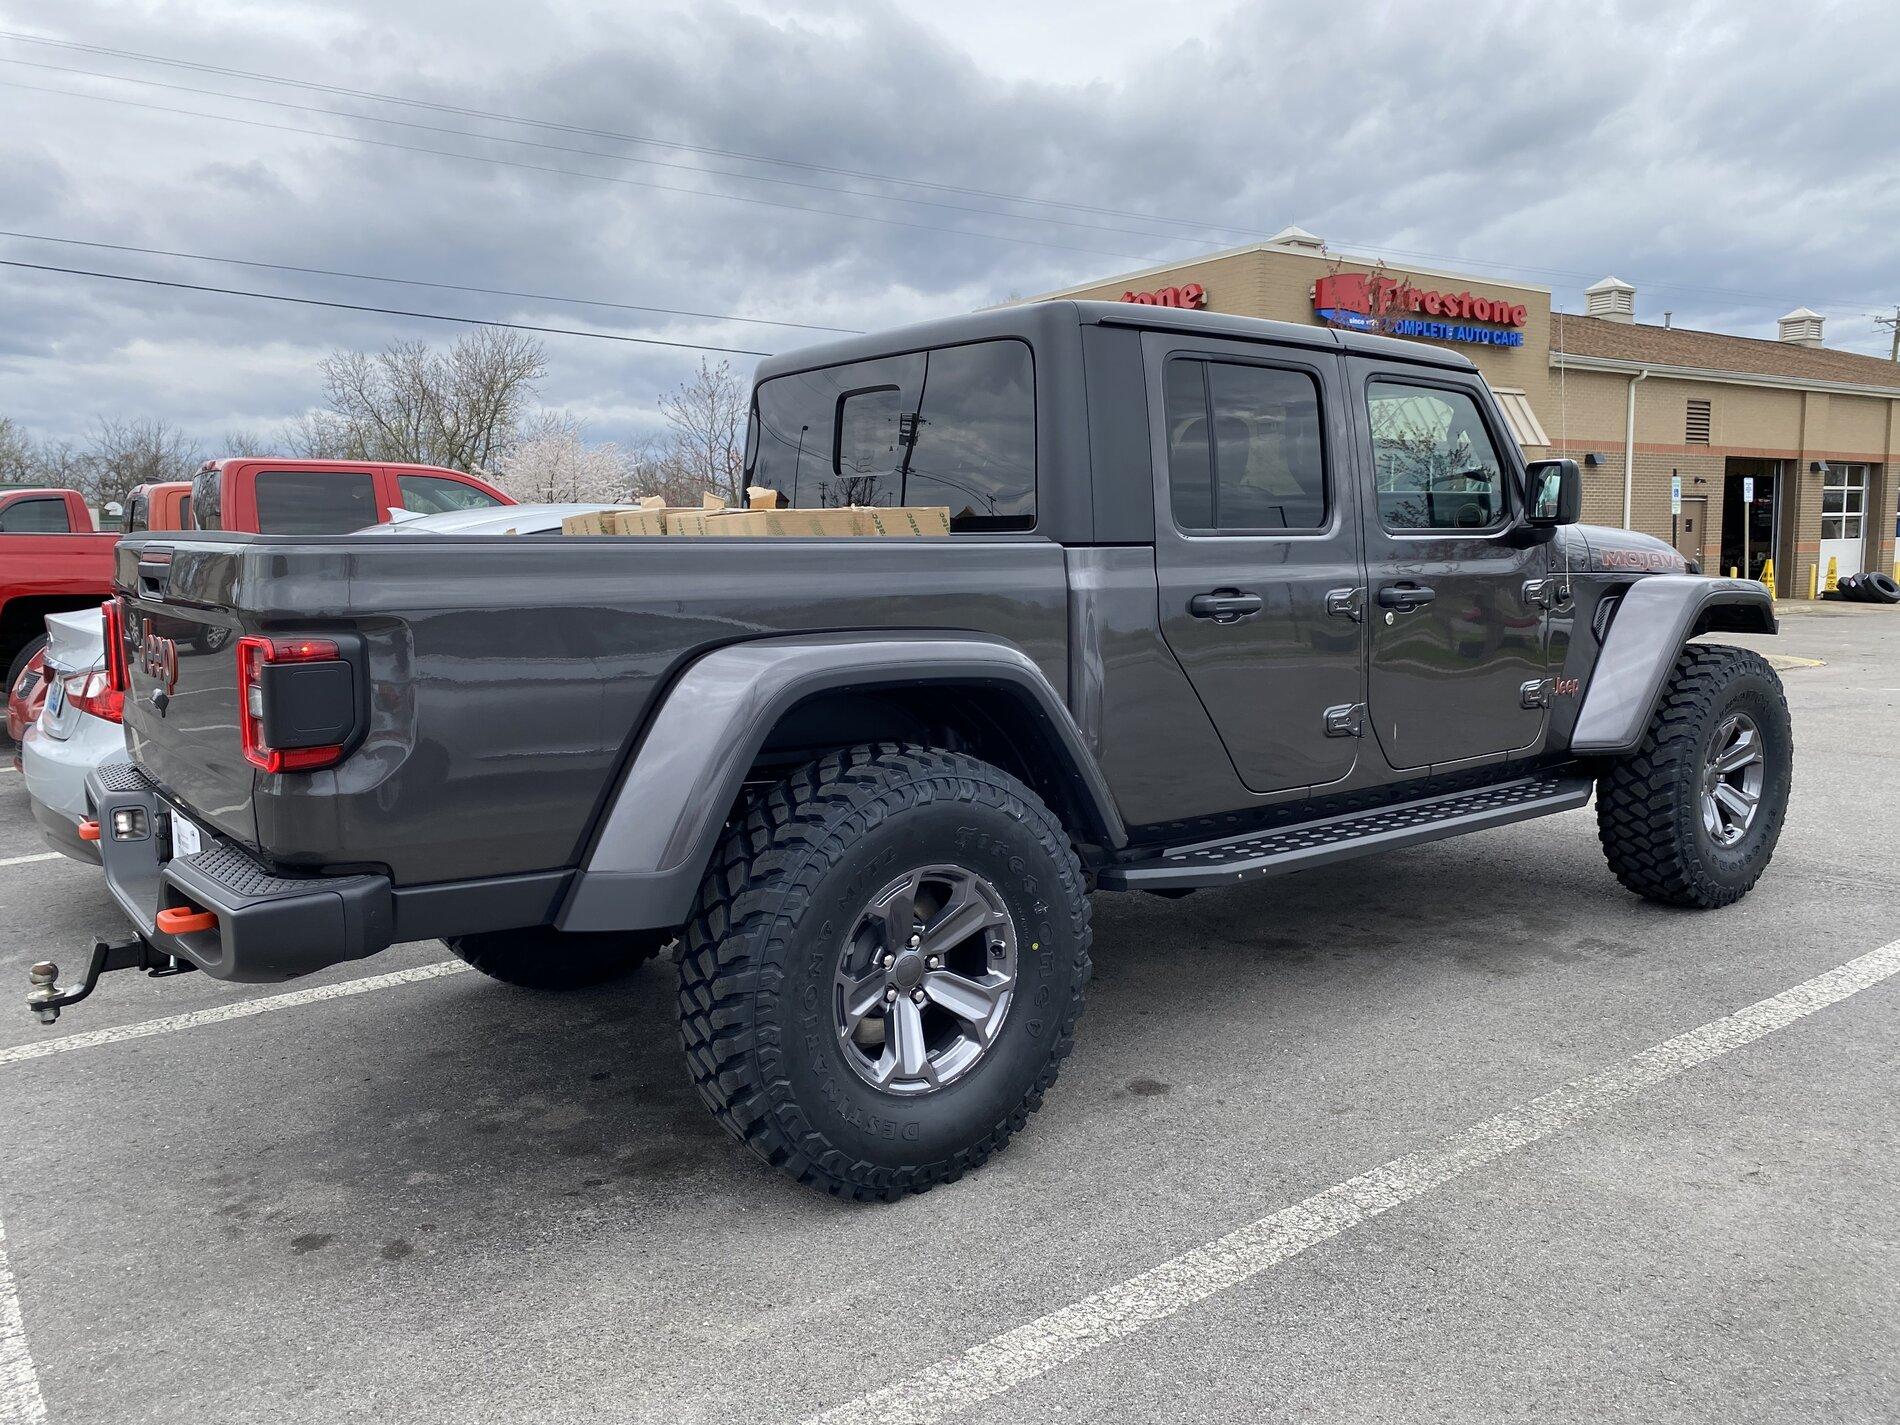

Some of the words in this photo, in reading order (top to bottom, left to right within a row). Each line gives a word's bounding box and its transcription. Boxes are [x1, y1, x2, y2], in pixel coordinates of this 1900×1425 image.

[1369, 276, 1528, 326] Firestone
[1456, 326, 1491, 344] AUTO
[1493, 329, 1524, 347] CARE
[1600, 549, 1686, 570] MOJAVE
[1553, 675, 1579, 699] Jeep
